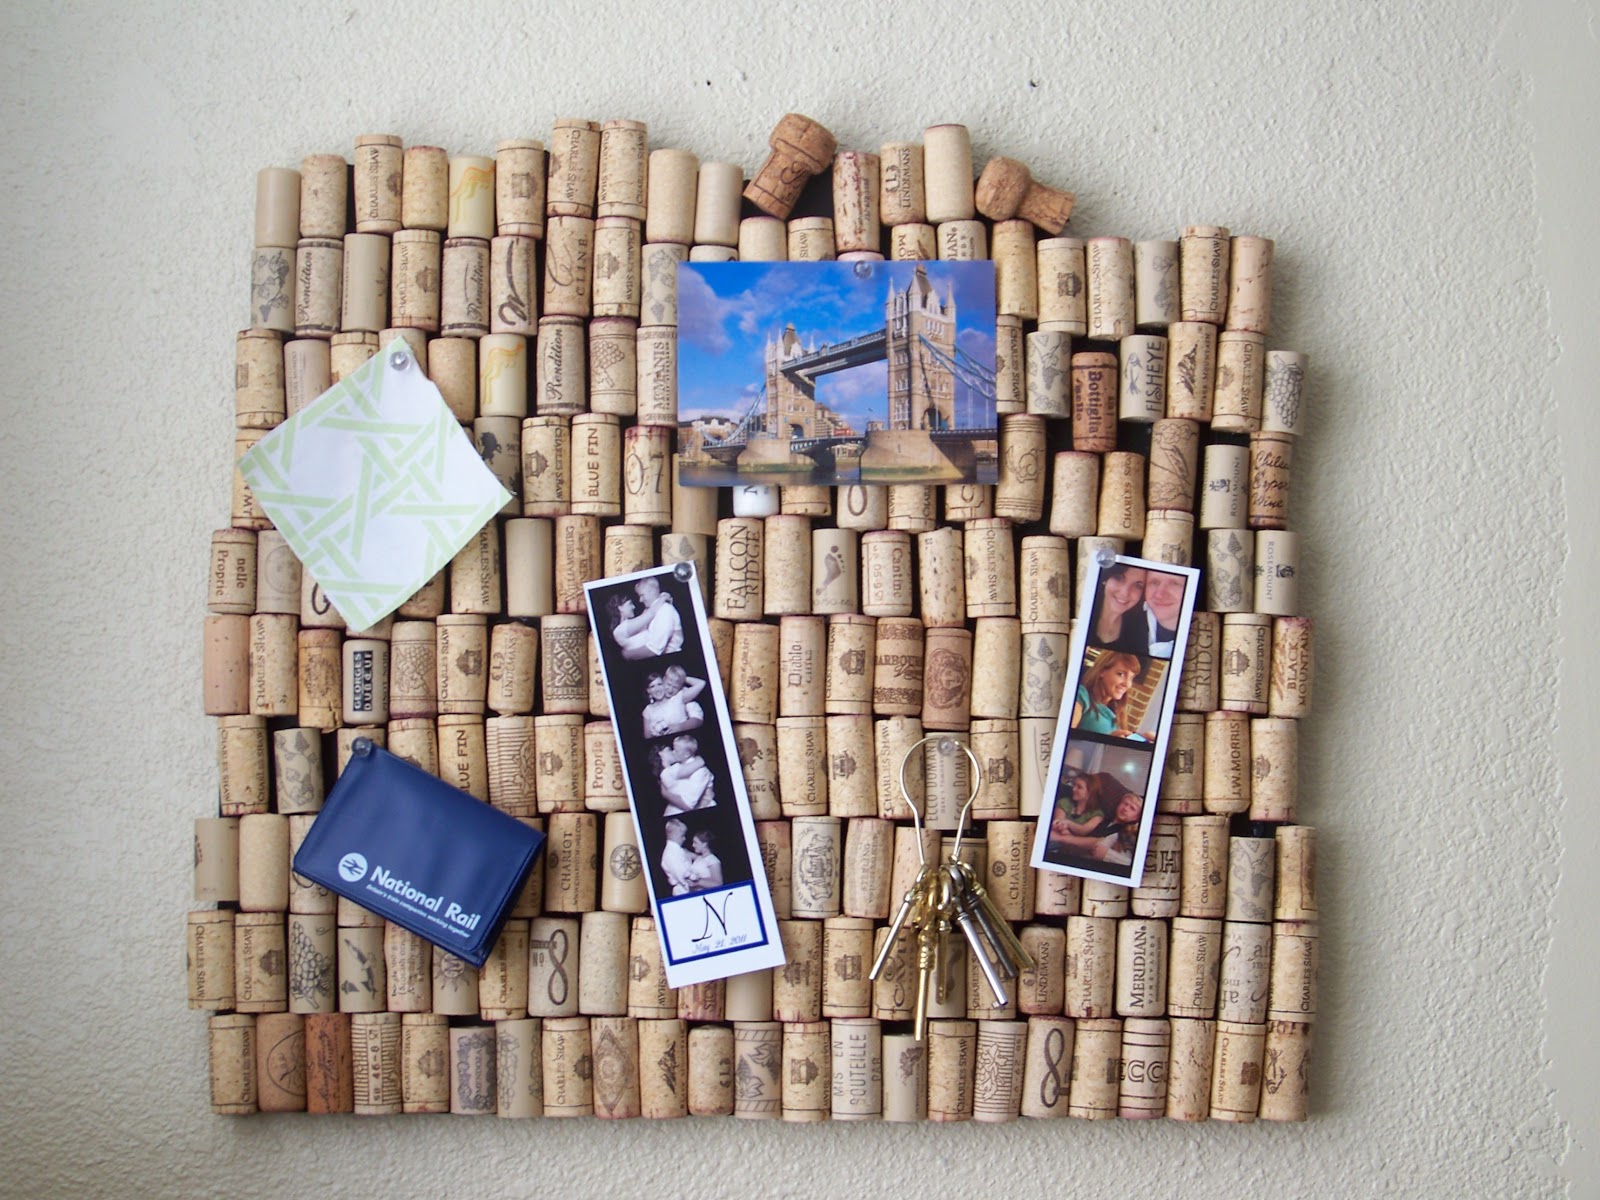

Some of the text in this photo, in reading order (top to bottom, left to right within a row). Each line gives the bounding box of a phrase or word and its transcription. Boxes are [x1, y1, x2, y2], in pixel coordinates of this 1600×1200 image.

[368, 146, 380, 219] CHARLES SHAW
[565, 131, 580, 200] CHARLES SHAW
[901, 148, 912, 209] LINDEMANS
[398, 243, 410, 316] CHARLES SHAW
[576, 238, 588, 296] CLINE
[625, 230, 635, 300] CHARLES SHAW
[799, 232, 809, 258] SHAW
[1209, 239, 1221, 311] CHARLES SHAW
[297, 251, 315, 322] Rendition
[466, 253, 486, 323] Rendition
[1092, 243, 1103, 329] CHARLES SHAW
[545, 328, 564, 401] Rendition
[653, 341, 666, 410] McMANIS
[1009, 328, 1021, 401] CHARLES SHAW
[1145, 340, 1163, 412] FISHEYE
[1200, 332, 1212, 411] BLACK MOUNTAIN
[1240, 342, 1254, 417] CHARLES SHAW
[1086, 370, 1105, 436] Bottiglia
[553, 427, 564, 500] CHARLES SHAW
[588, 428, 600, 497] BLUE FIN
[1229, 456, 1241, 518] ROSEMOUNT
[1121, 480, 1134, 530] CHARLES
[236, 557, 248, 589] nelle
[480, 526, 491, 606] HARLES SHAW
[562, 525, 580, 603] WILLIAMSBURG
[614, 538, 624, 562] SHAW
[726, 525, 748, 610] FALCON
[747, 529, 761, 596] RIDGE
[892, 546, 905, 599] Cantine
[985, 529, 997, 601] CHARLES SHAW
[1266, 540, 1275, 601] ROSEMOUNT
[1029, 550, 1040, 622] CHARLES SHAW
[254, 616, 267, 709] CHARLES SHAW
[353, 650, 364, 711] GEORGES
[380, 650, 389, 712] PINOT NOIR
[439, 628, 450, 700] CHARLES SHAW
[502, 634, 518, 698] LINDEMANS
[553, 642, 583, 683] RIOJA
[786, 640, 803, 688] Diablo
[805, 648, 813, 684] CHILE
[1197, 619, 1213, 686] RIDGE
[1255, 627, 1266, 701] CHARLES SHAW
[1286, 641, 1298, 691] BLACK
[1299, 618, 1310, 707] MOUNTAIN
[257, 730, 266, 803] CHARLES SHAW
[457, 729, 470, 758] FIN
[569, 725, 579, 798] CHARLES SHAW
[592, 740, 605, 790] Proprie
[805, 729, 818, 804] CHARLES SHAW
[880, 724, 893, 812] CHARLES SHAW
[1039, 731, 1052, 762] SERA
[1229, 719, 1242, 771] MORRIS
[925, 794, 939, 822] ECCO
[560, 830, 573, 892] CHARIOT
[861, 842, 871, 892] STERLING
[1008, 839, 1022, 901] CHARIOT
[1200, 861, 1209, 904] COLUMBIA
[369, 864, 485, 934] National Rail
[690, 892, 734, 943] N
[195, 925, 206, 999] CHARLES SHAW
[242, 927, 254, 1002] CHARLES SHAW
[729, 934, 748, 946] 2011
[812, 927, 823, 1017] CHARLES SHAW
[821, 930, 831, 1005] CHARLES SHAW
[892, 931, 908, 1008] CAVIT
[1038, 941, 1050, 1004] LINDEMANS
[1080, 922, 1096, 1011] CHARLES SHAW
[1129, 930, 1147, 1009] MERIDIAN
[1148, 935, 1156, 1004] VINEYARDS
[1192, 934, 1207, 1007] CHARLES SHAW
[658, 976, 669, 1008] SHAW
[968, 962, 979, 1009] CHARLES
[1301, 939, 1312, 1012] CHARLES SHAW
[242, 1028, 252, 1103] CHARLES SHAW
[403, 1029, 413, 1102] CHARLES SHAW
[474, 1049, 484, 1094] MENDOZA
[557, 1031, 570, 1105] CHARLES SHAW
[831, 1040, 844, 1098] MIS EN
[849, 1033, 867, 1106] BOUTEILLE
[870, 1056, 882, 1083] PAR
[956, 1037, 969, 1113] CHARLES SHAW
[1217, 1037, 1231, 1106] CHARLES SHAW
